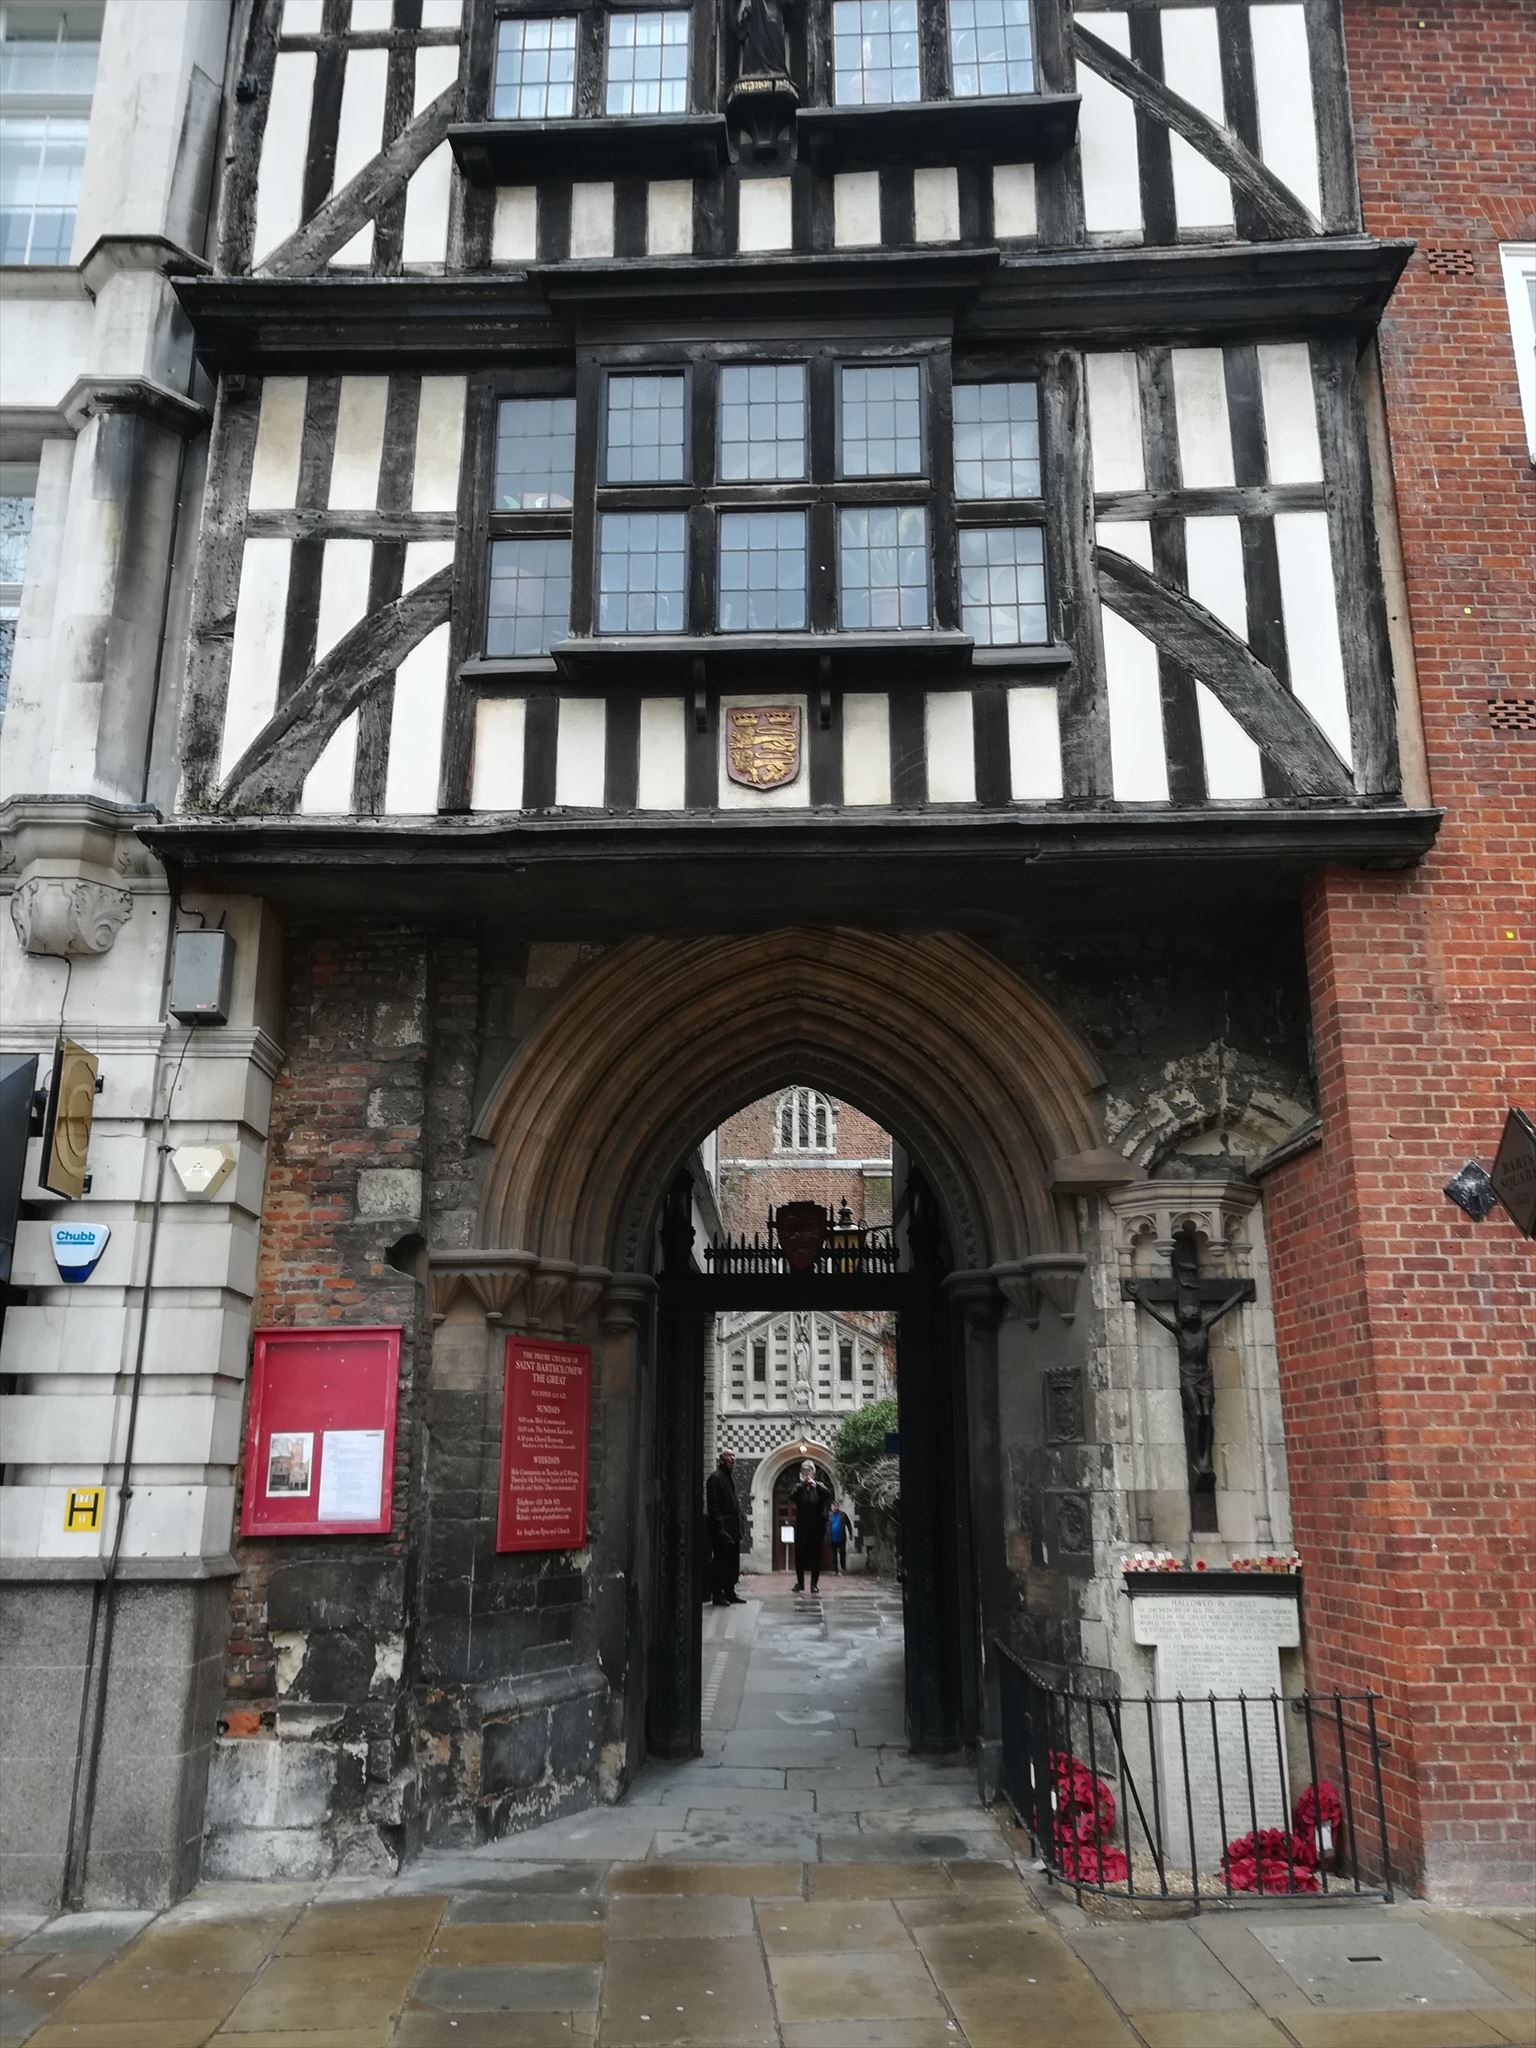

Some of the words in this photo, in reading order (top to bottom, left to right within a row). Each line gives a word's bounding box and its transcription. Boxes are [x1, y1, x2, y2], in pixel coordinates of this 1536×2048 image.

[56, 1231, 96, 1241] Chubb
[515, 1360, 535, 1371] SAINT
[536, 1362, 584, 1376] BARTHOLOMEW
[532, 1373, 546, 1384] THE
[546, 1375, 567, 1386] GREAT
[536, 1404, 561, 1414] SUNDAYS
[533, 1455, 560, 1465] WEEKDAYS
[67, 1493, 99, 1527] H
[1171, 1599, 1214, 1607] HALLOWED
[1229, 1600, 1257, 1608] CHRIST
